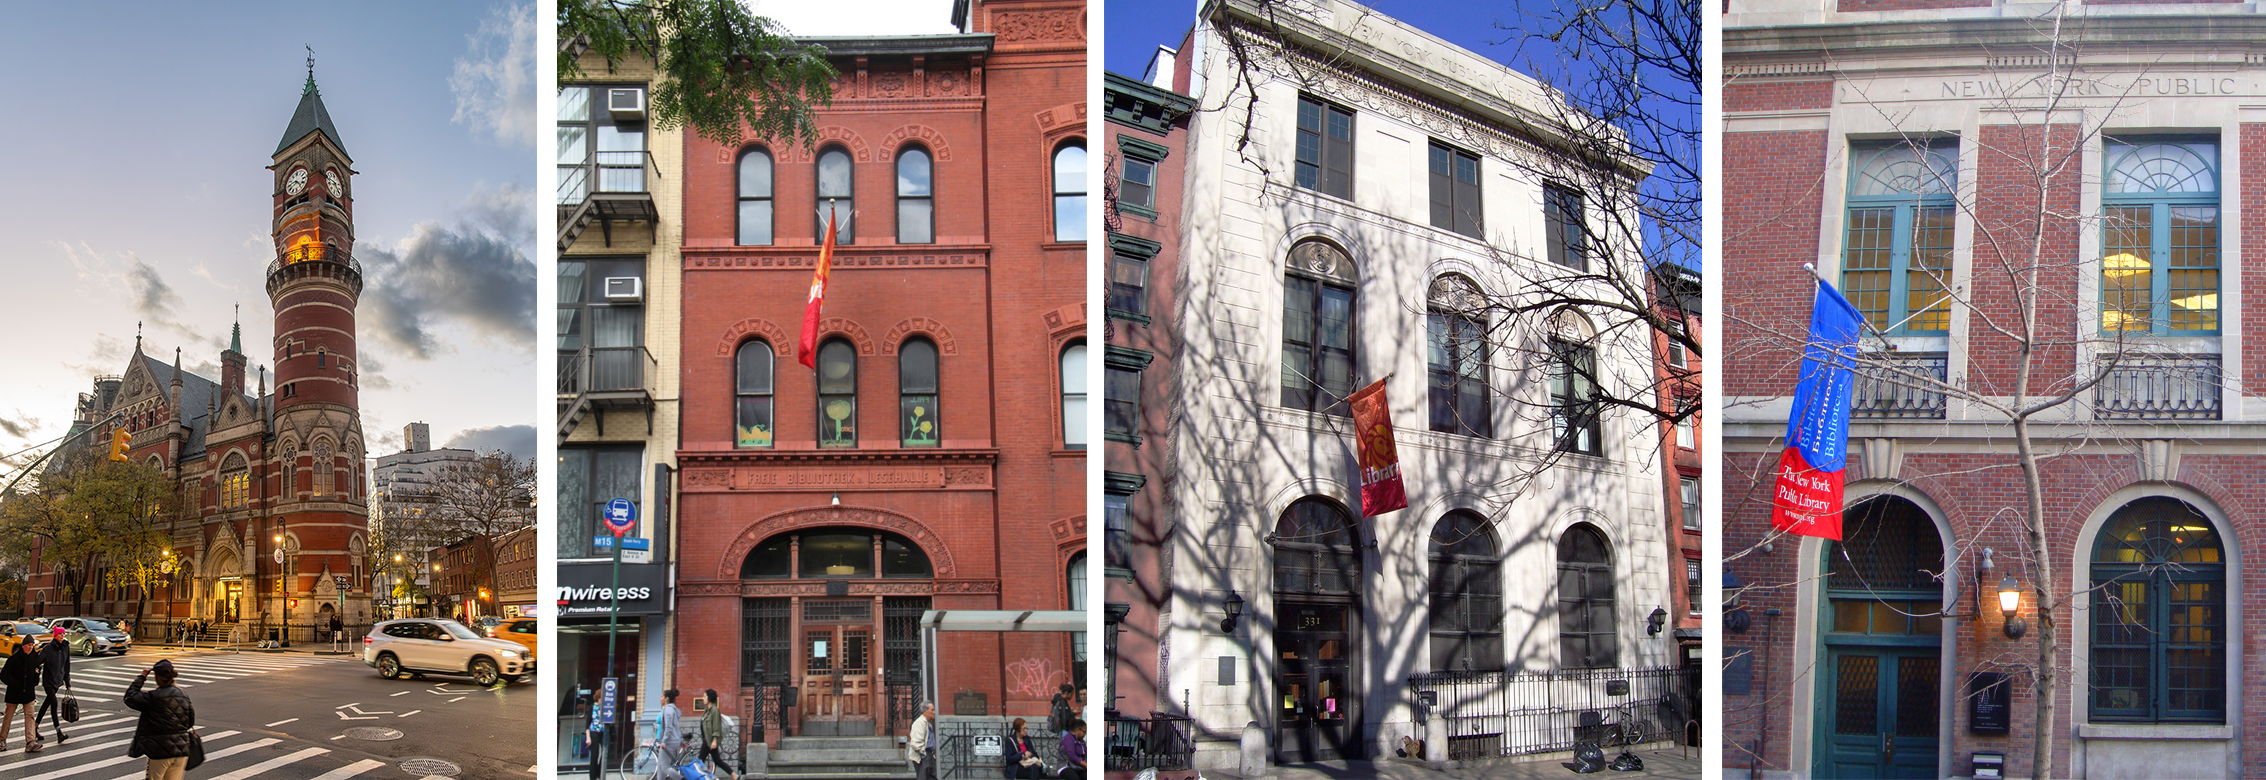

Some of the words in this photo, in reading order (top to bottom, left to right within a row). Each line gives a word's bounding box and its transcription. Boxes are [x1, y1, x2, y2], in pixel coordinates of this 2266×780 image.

[1393, 36, 1433, 66] YORK
[1441, 57, 1488, 87] PUBLIC
[1941, 80, 1998, 97] NEW
[2034, 77, 2101, 96] YORK
[2138, 77, 2235, 95] PUBLIC
[748, 472, 777, 485] FREIE
[786, 472, 855, 485] BIBLIOTHEK
[868, 471, 929, 484] LESEHALLE
[1360, 461, 1399, 487] Library
[1811, 476, 1831, 493] York
[1798, 493, 1830, 514] Library
[595, 537, 612, 546] M15
[1304, 617, 1321, 626] 331
